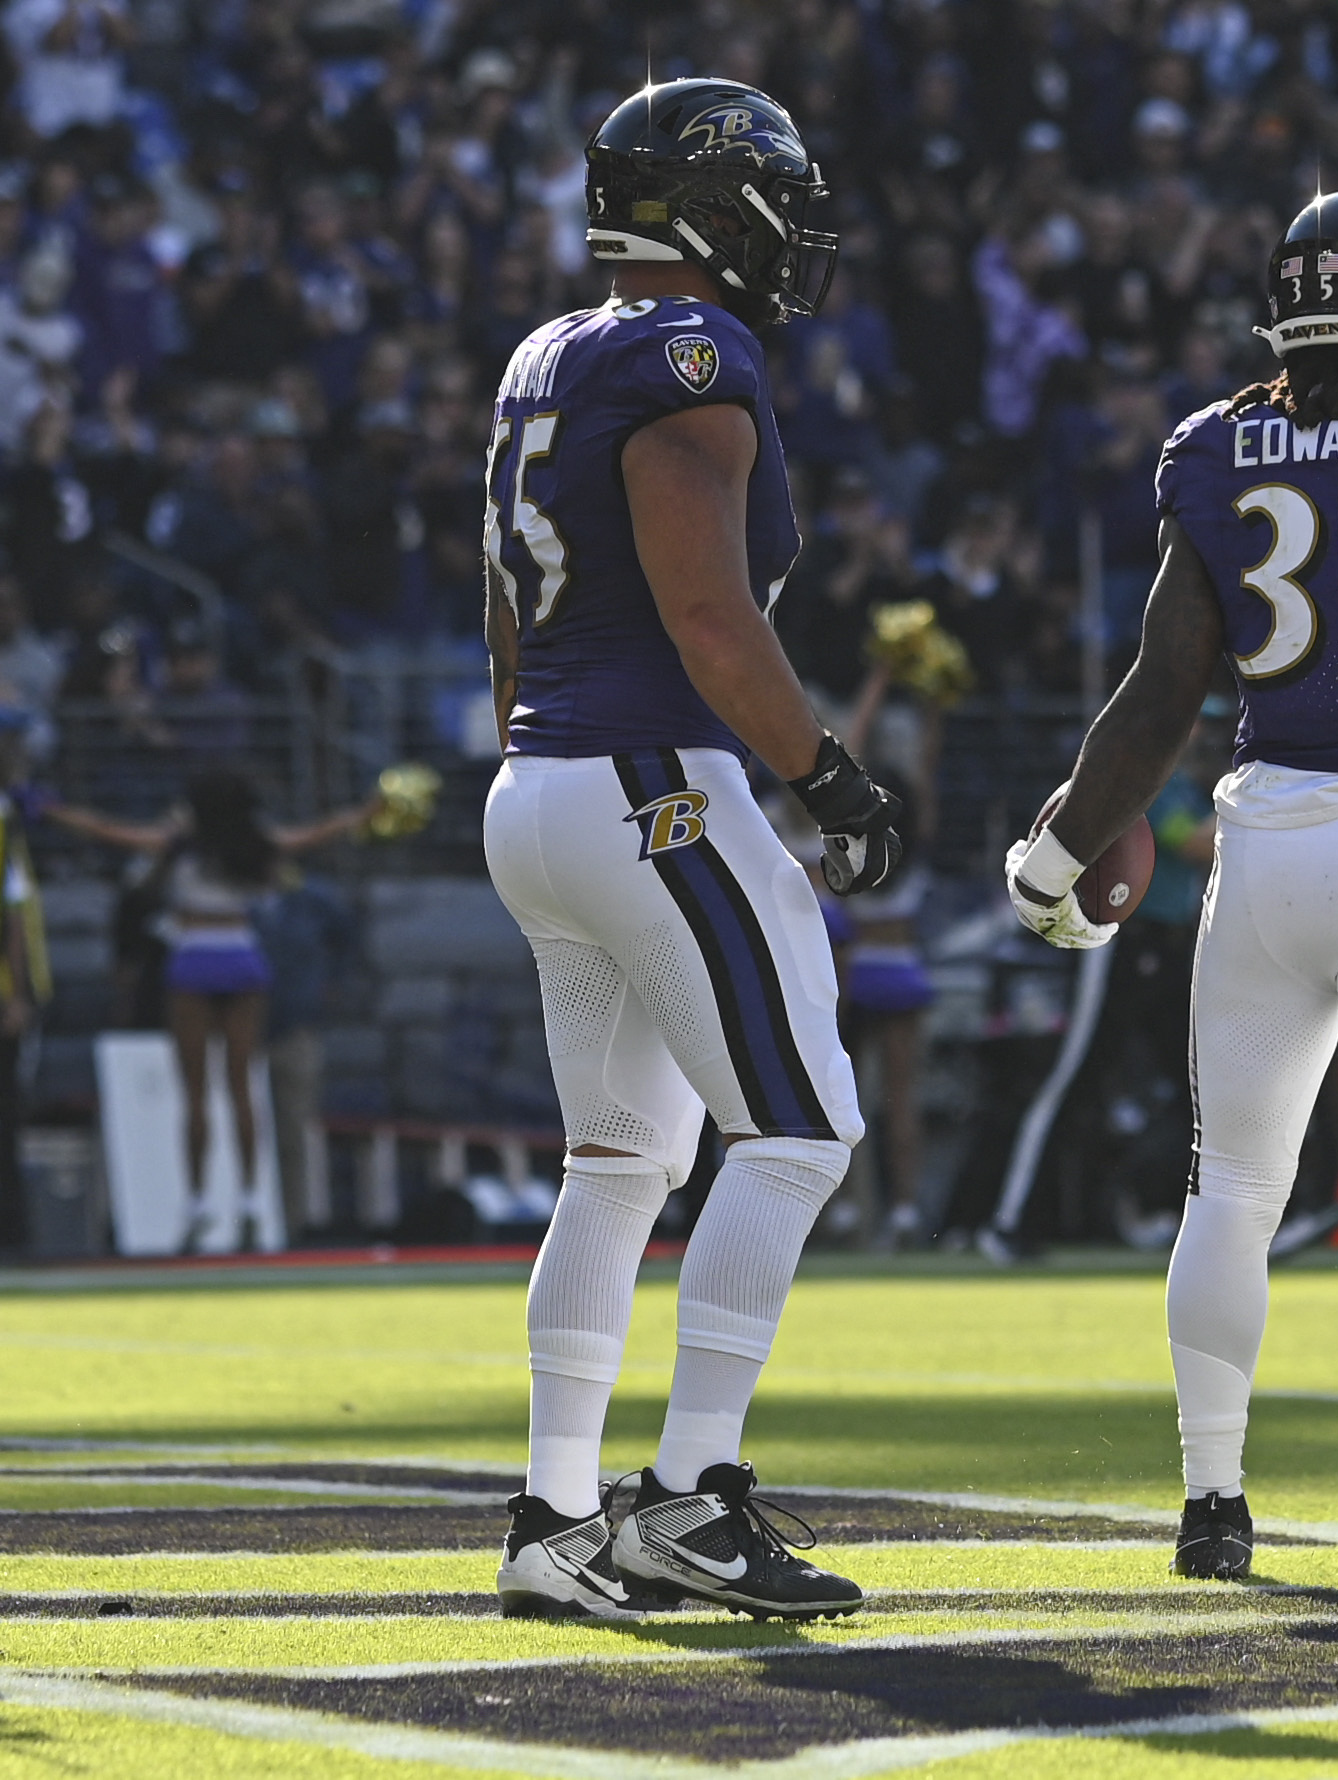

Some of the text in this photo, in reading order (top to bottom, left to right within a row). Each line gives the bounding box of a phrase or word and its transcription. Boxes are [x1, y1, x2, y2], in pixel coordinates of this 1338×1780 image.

[595, 186, 606, 216] 5
[672, 339, 709, 349] RAVENS
[622, 779, 709, 862] B
[639, 1544, 692, 1578] FORCE
